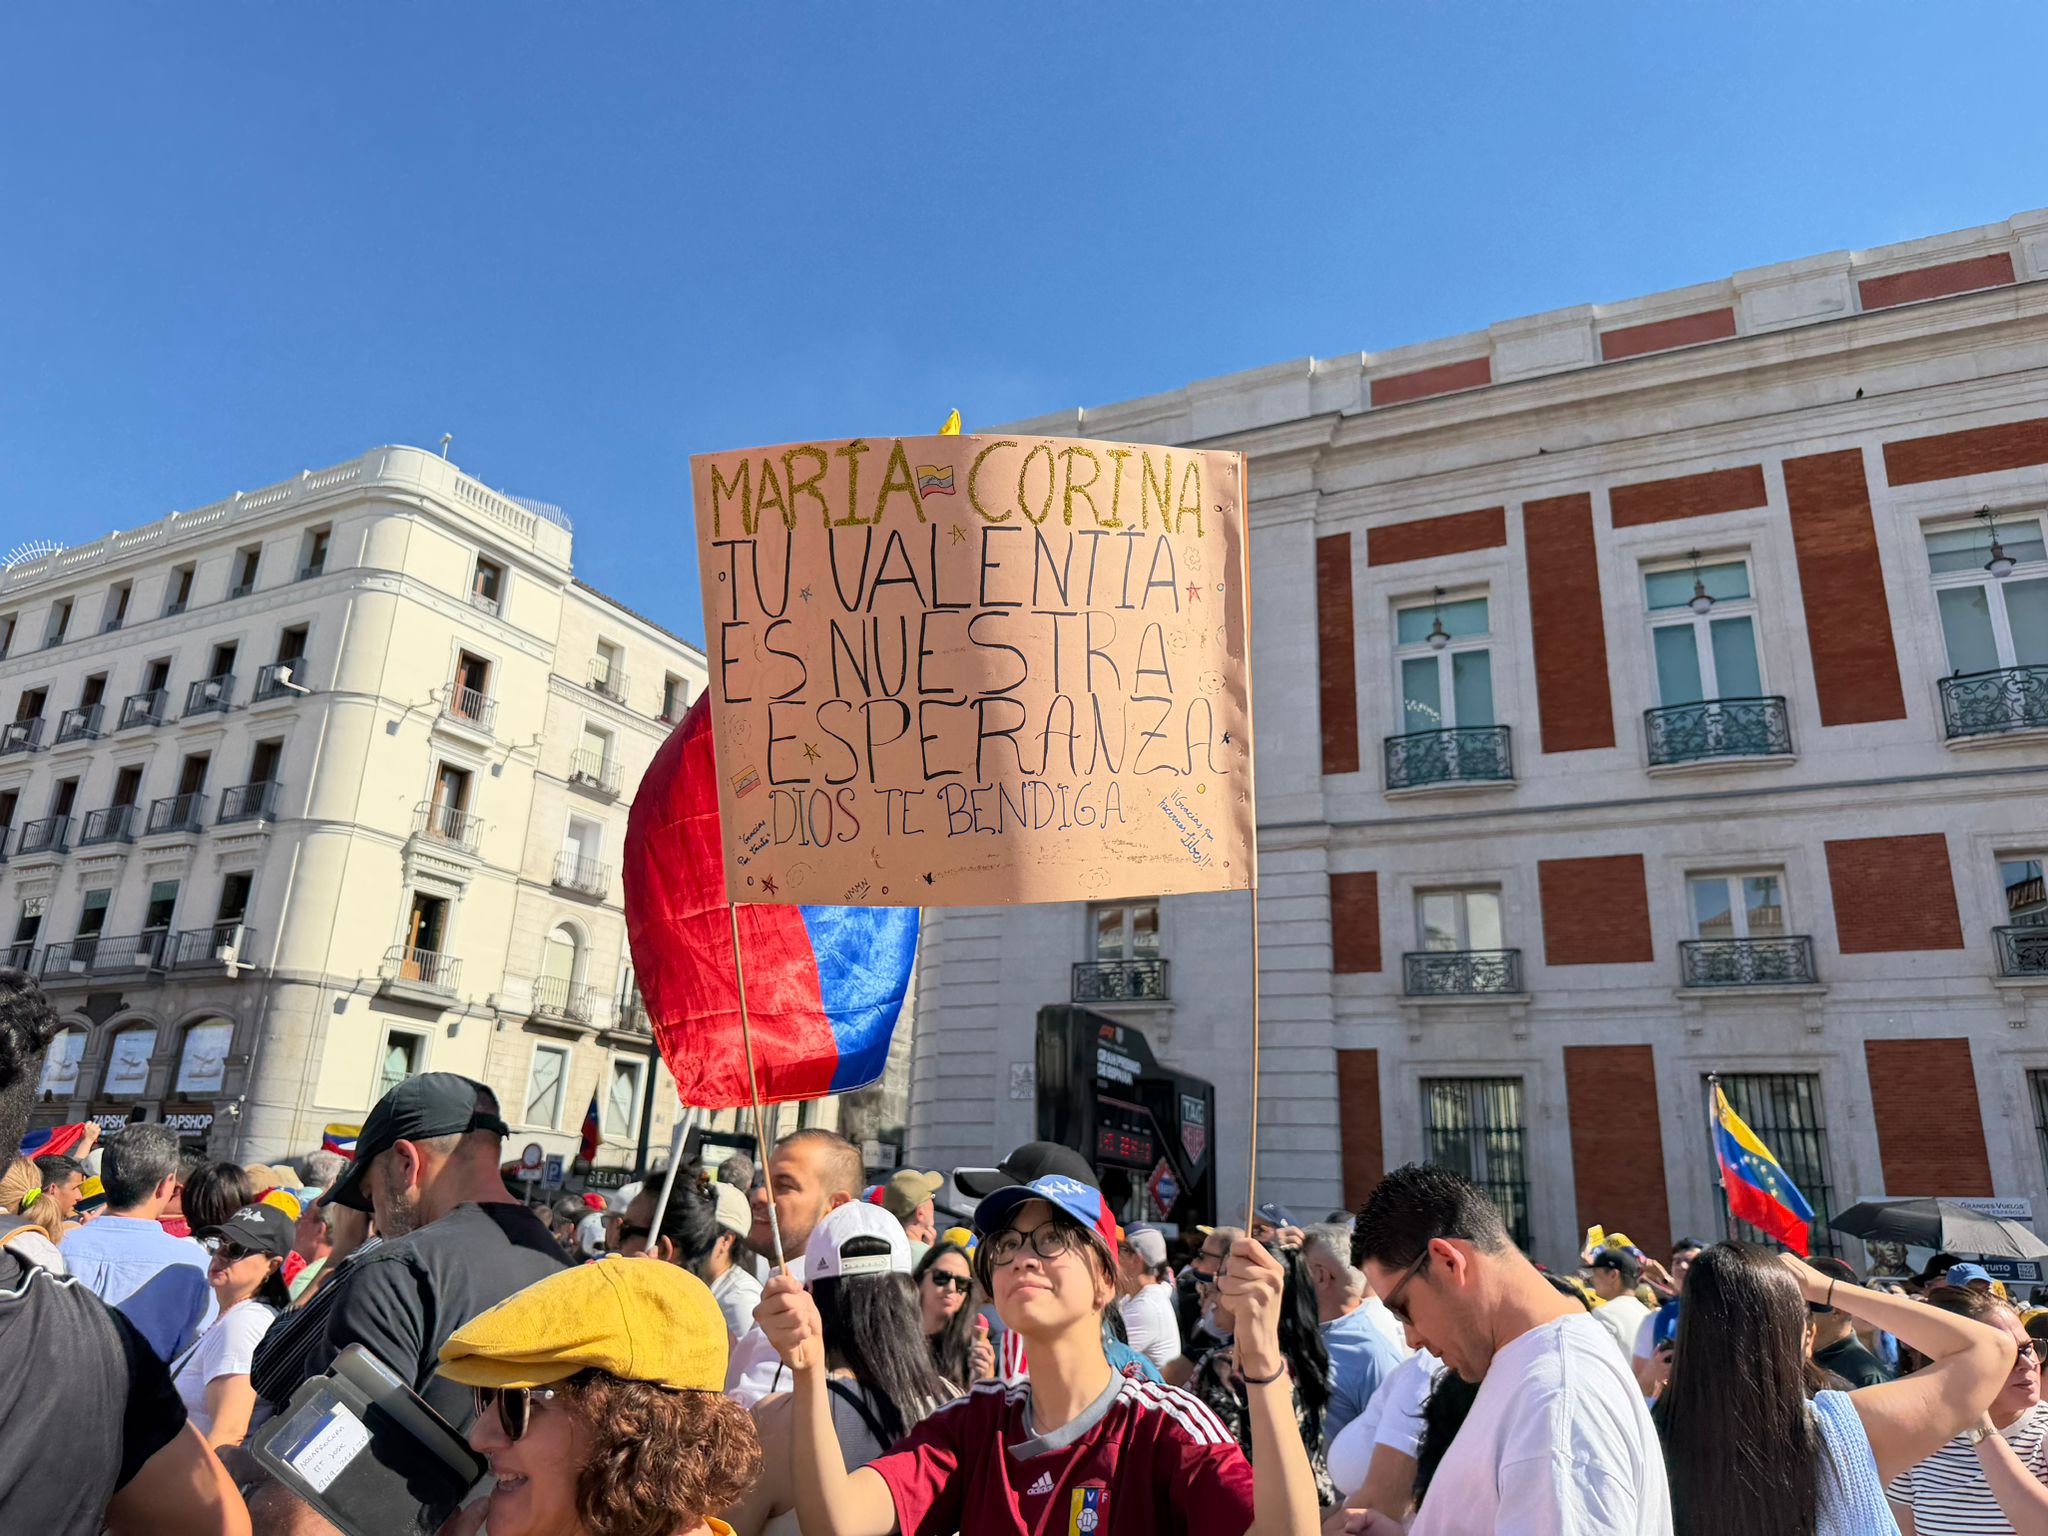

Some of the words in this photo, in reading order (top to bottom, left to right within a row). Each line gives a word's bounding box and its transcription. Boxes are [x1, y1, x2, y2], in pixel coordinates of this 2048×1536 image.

[967, 440, 1205, 538] CORINA
[712, 529, 792, 620] TU
[828, 523, 1180, 613] VALENTÍA
[721, 619, 807, 704] ES
[830, 611, 1174, 698] NUESTRA
[767, 692, 1230, 785] ESPERANZA
[768, 787, 860, 848] DIOS
[874, 788, 925, 836] TE
[937, 781, 1126, 838] BENDIGA
[165, 1114, 213, 1129] ZAPSHOP
[1182, 1101, 1204, 1124] TAG
